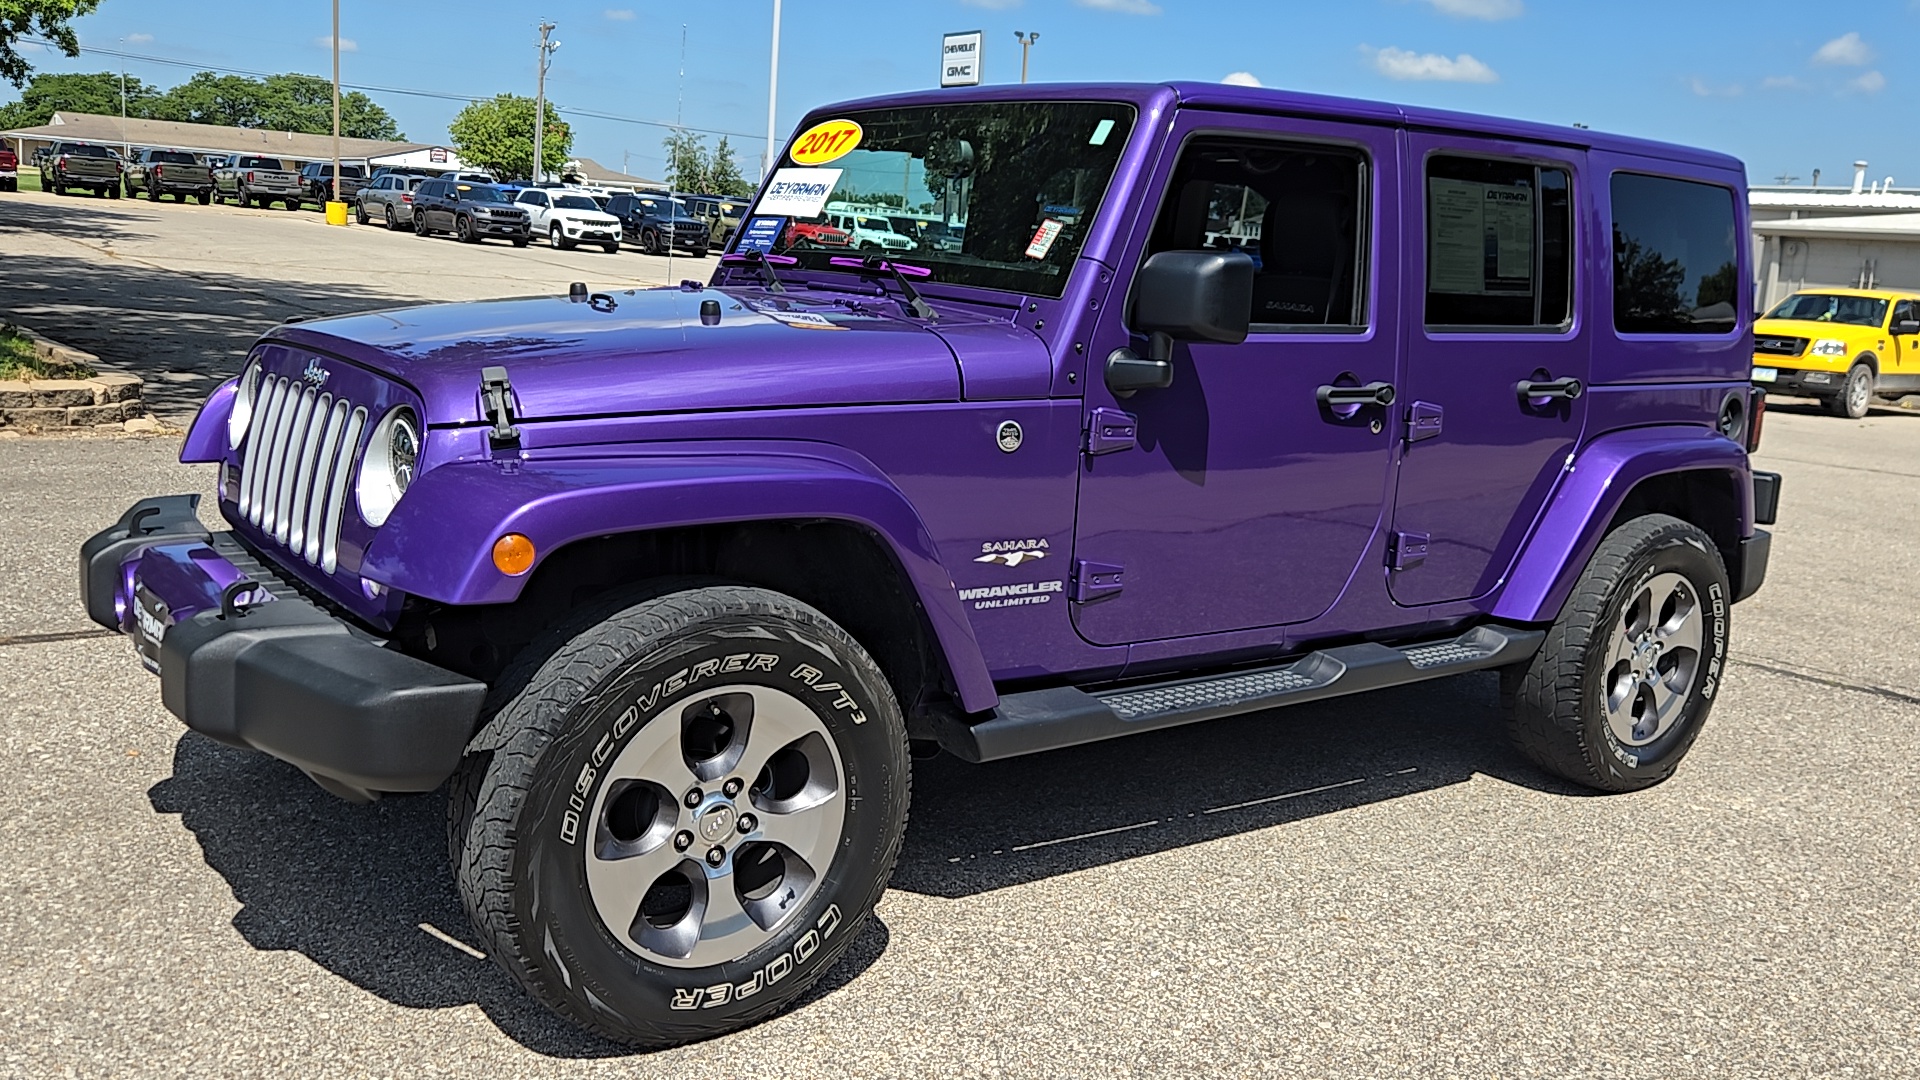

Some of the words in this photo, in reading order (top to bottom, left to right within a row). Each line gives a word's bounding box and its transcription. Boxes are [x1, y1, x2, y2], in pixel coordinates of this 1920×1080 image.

[945, 43, 976, 54] CHEVROLET
[947, 65, 971, 77] GMC
[795, 129, 857, 156] 2017
[769, 182, 831, 197] DEYARMAN
[1486, 190, 1528, 202] DEYARMAN
[981, 538, 1049, 553] SAHARA
[959, 580, 1063, 601] WRANGLER
[974, 595, 1051, 610] UNLIMITED
[1701, 582, 1725, 699] COOPER
[560, 653, 779, 845] DISCOVERER
[670, 903, 843, 1010] COOPER
